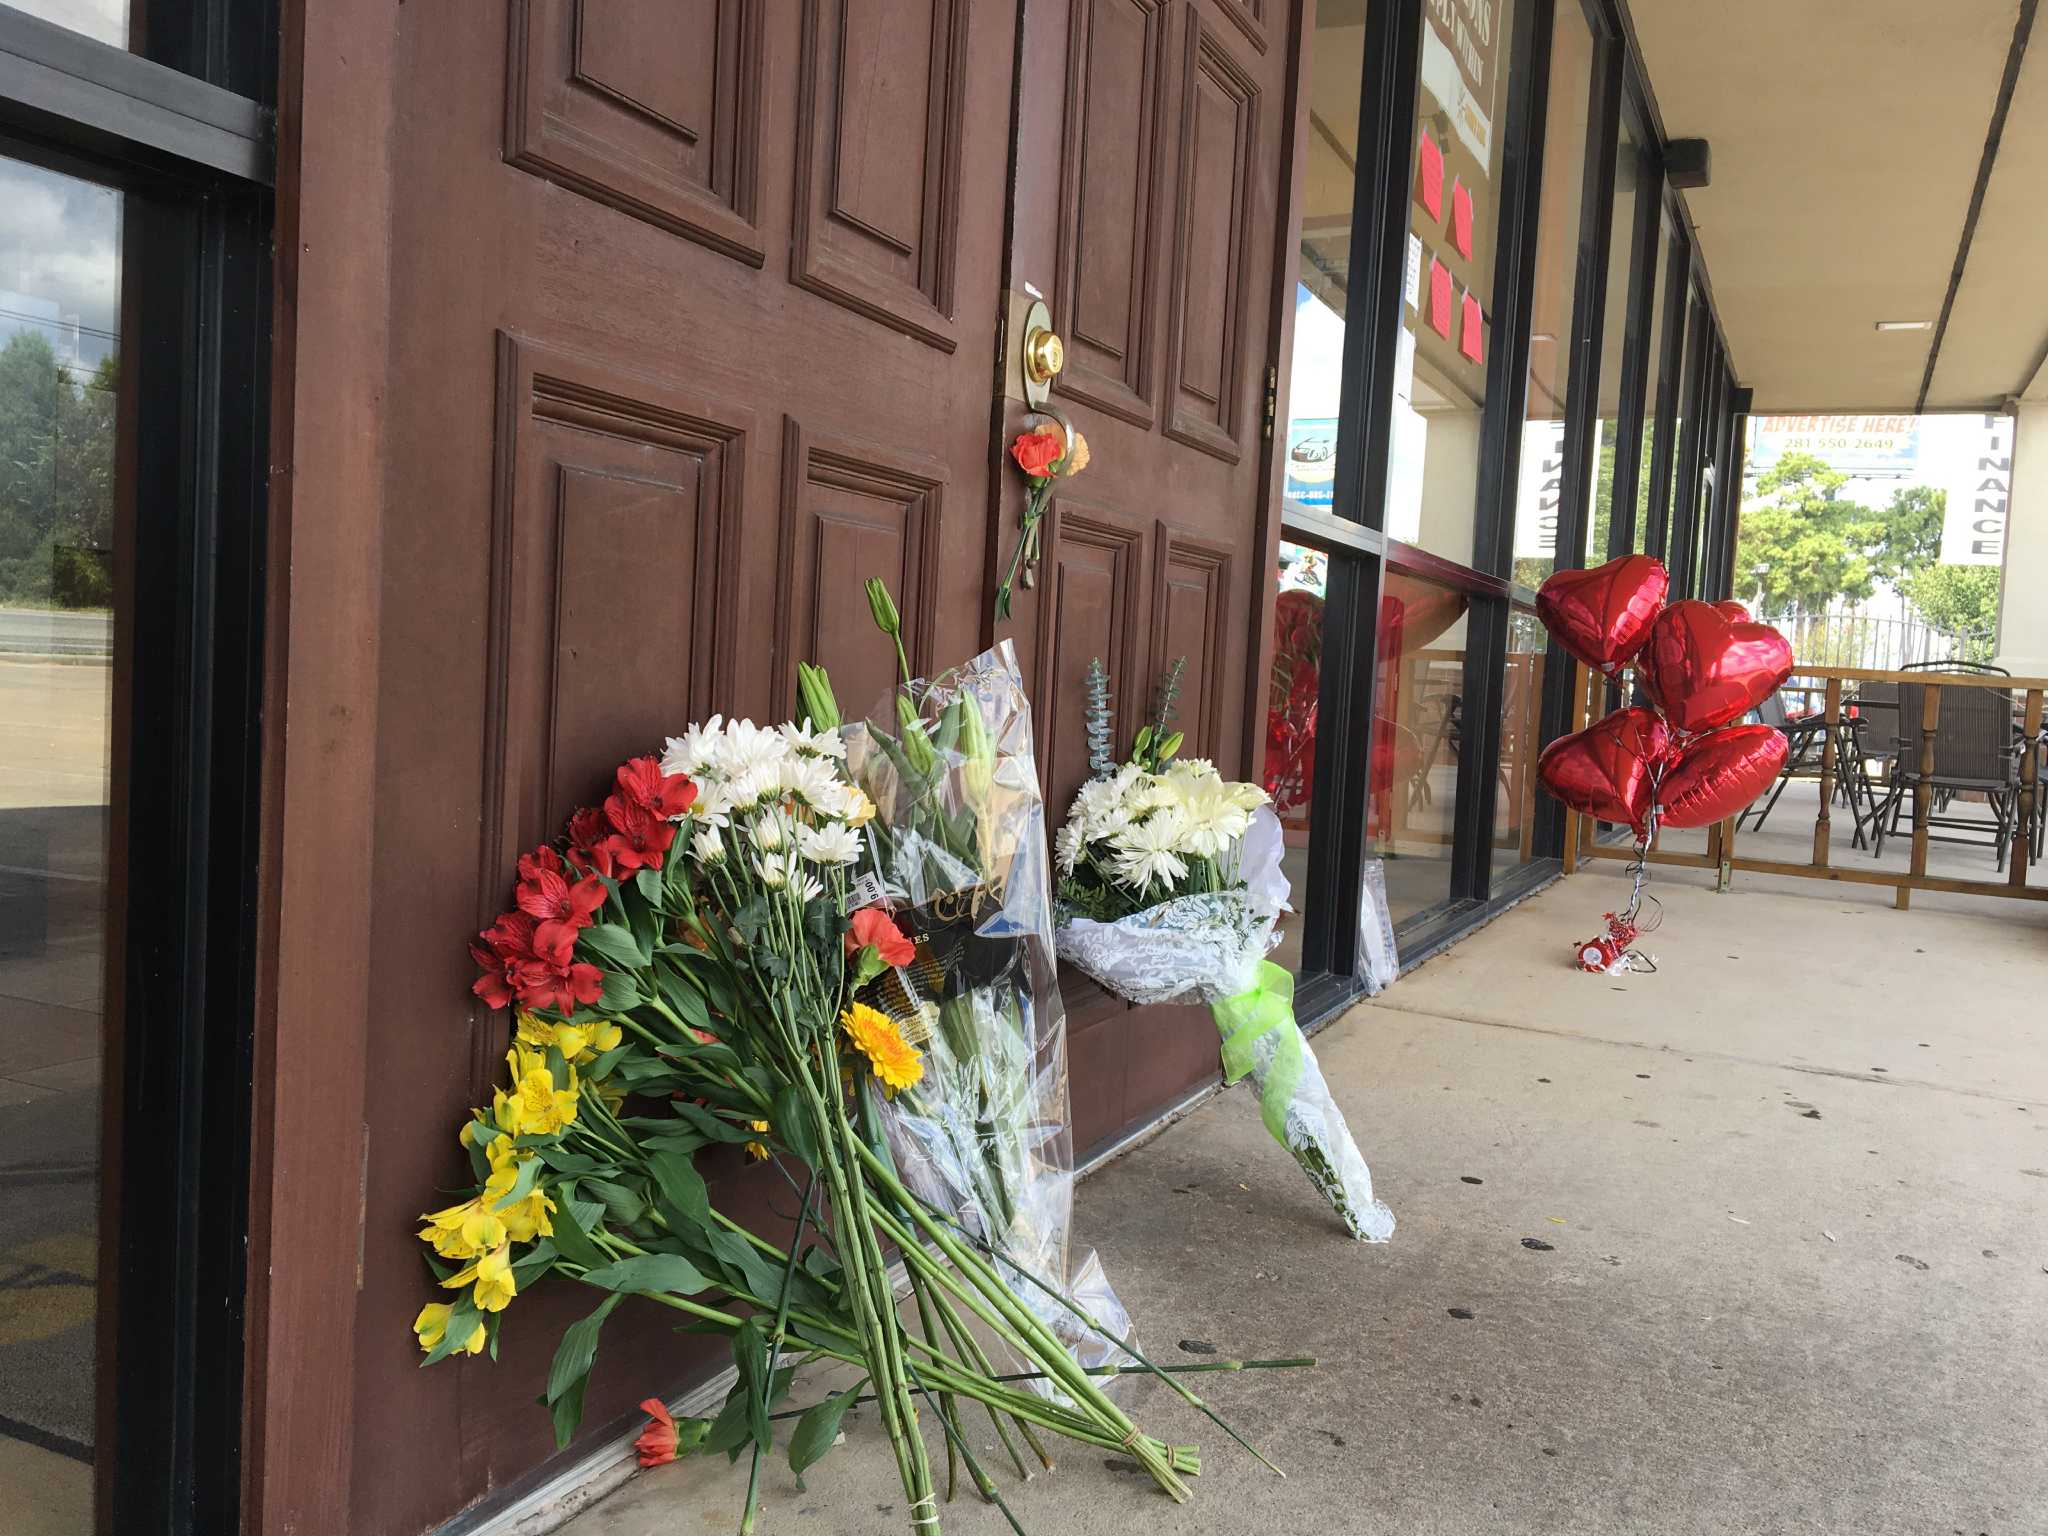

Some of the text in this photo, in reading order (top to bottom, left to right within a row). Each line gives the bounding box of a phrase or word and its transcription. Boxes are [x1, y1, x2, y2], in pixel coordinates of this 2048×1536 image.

[1762, 415, 1857, 432] ADVERTISE
[1784, 438, 1894, 449] 281 550 2649
[1971, 415, 2010, 555] FINANCE
